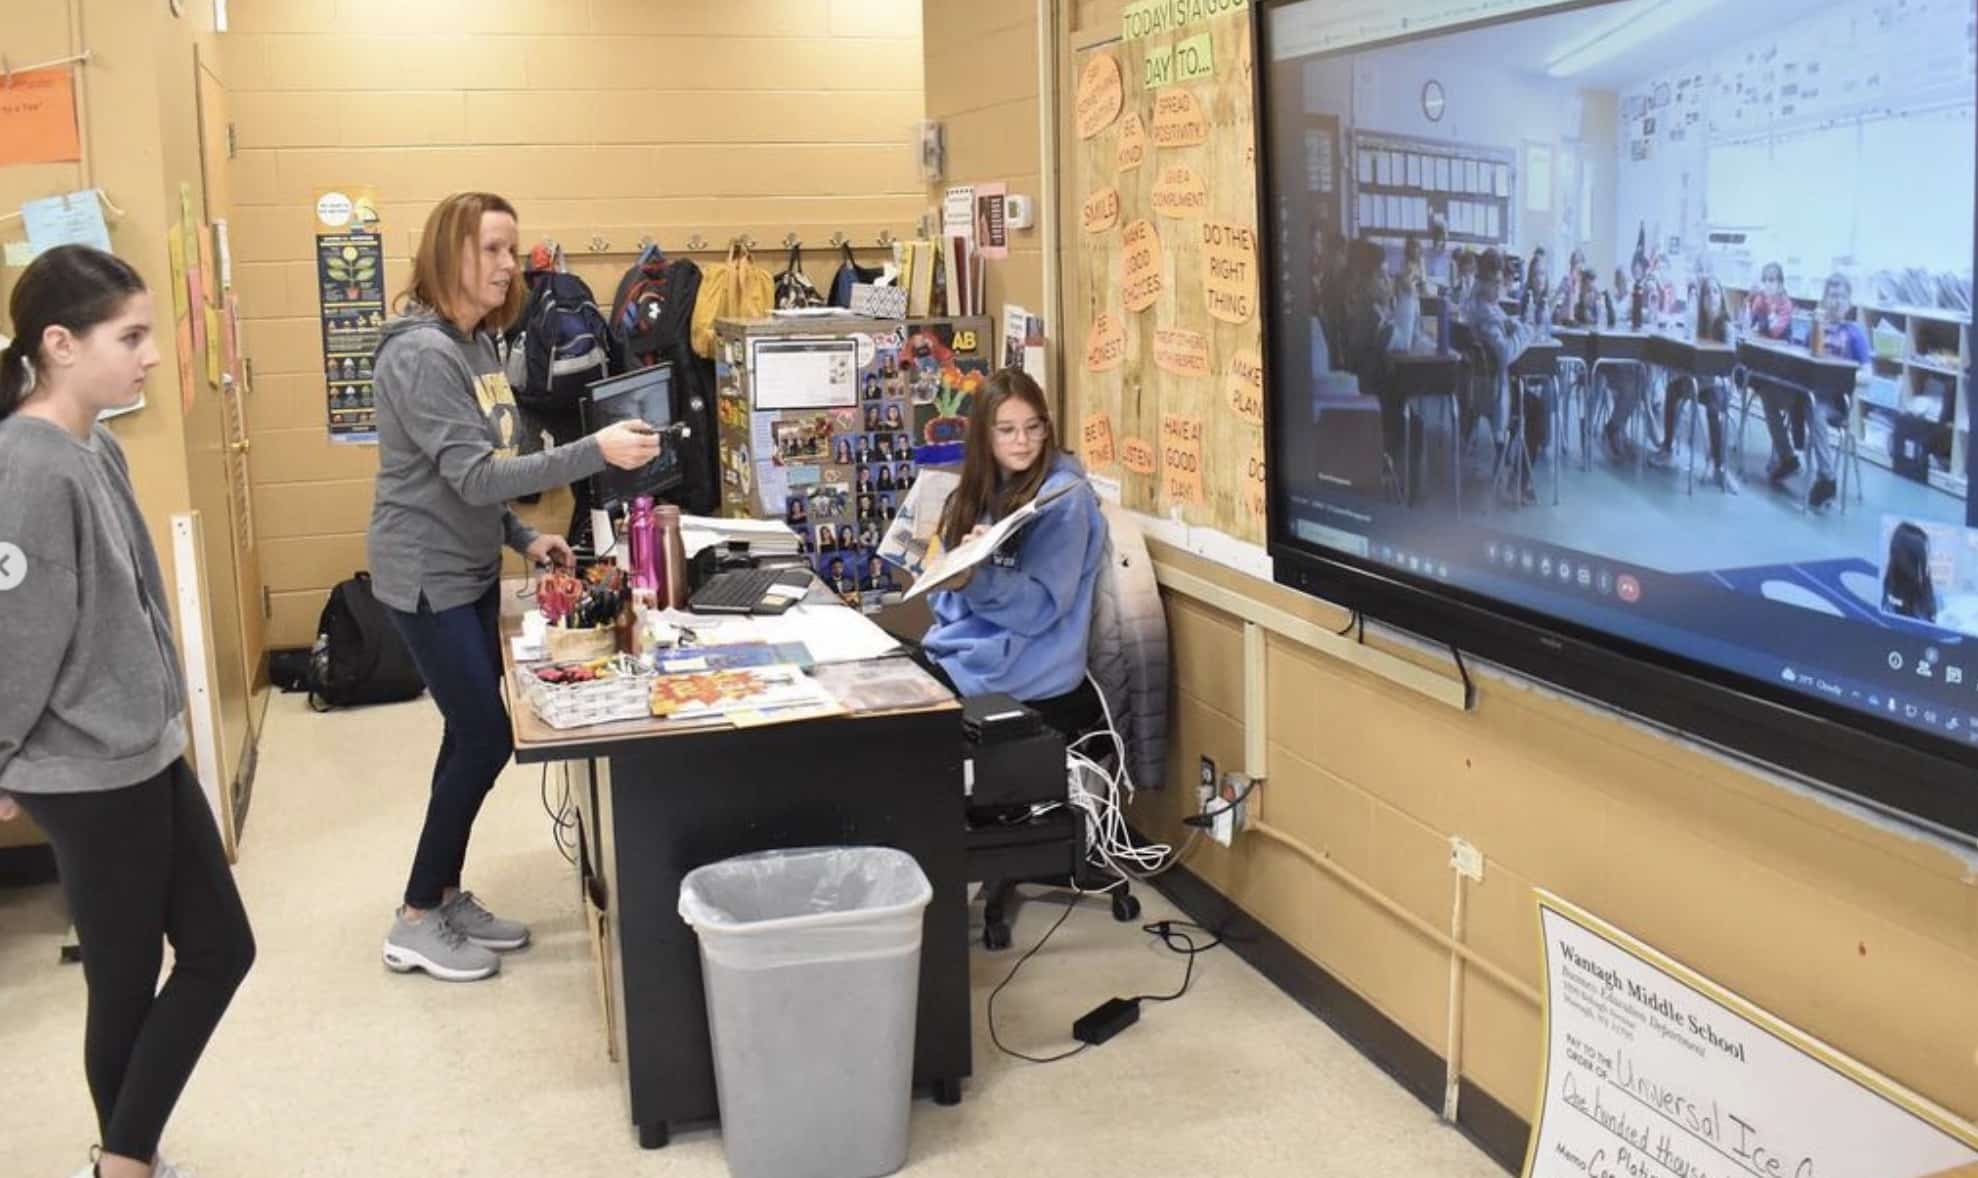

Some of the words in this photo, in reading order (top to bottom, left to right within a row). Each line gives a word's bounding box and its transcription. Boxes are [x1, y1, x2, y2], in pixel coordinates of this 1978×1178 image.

[1145, 56, 1170, 85] DAY
[1203, 223, 1222, 246] DO
[1223, 226, 1251, 251] THE
[1210, 255, 1247, 282] RIGHT
[951, 330, 978, 354] AB
[1166, 446, 1196, 473] GOOD
[1558, 939, 1624, 992] Wantagh
[1626, 979, 1686, 1028] Middle
[1687, 1013, 1747, 1065] School
[1616, 1048, 1722, 1143] Universal
[1593, 1086, 1650, 1152] hundred
